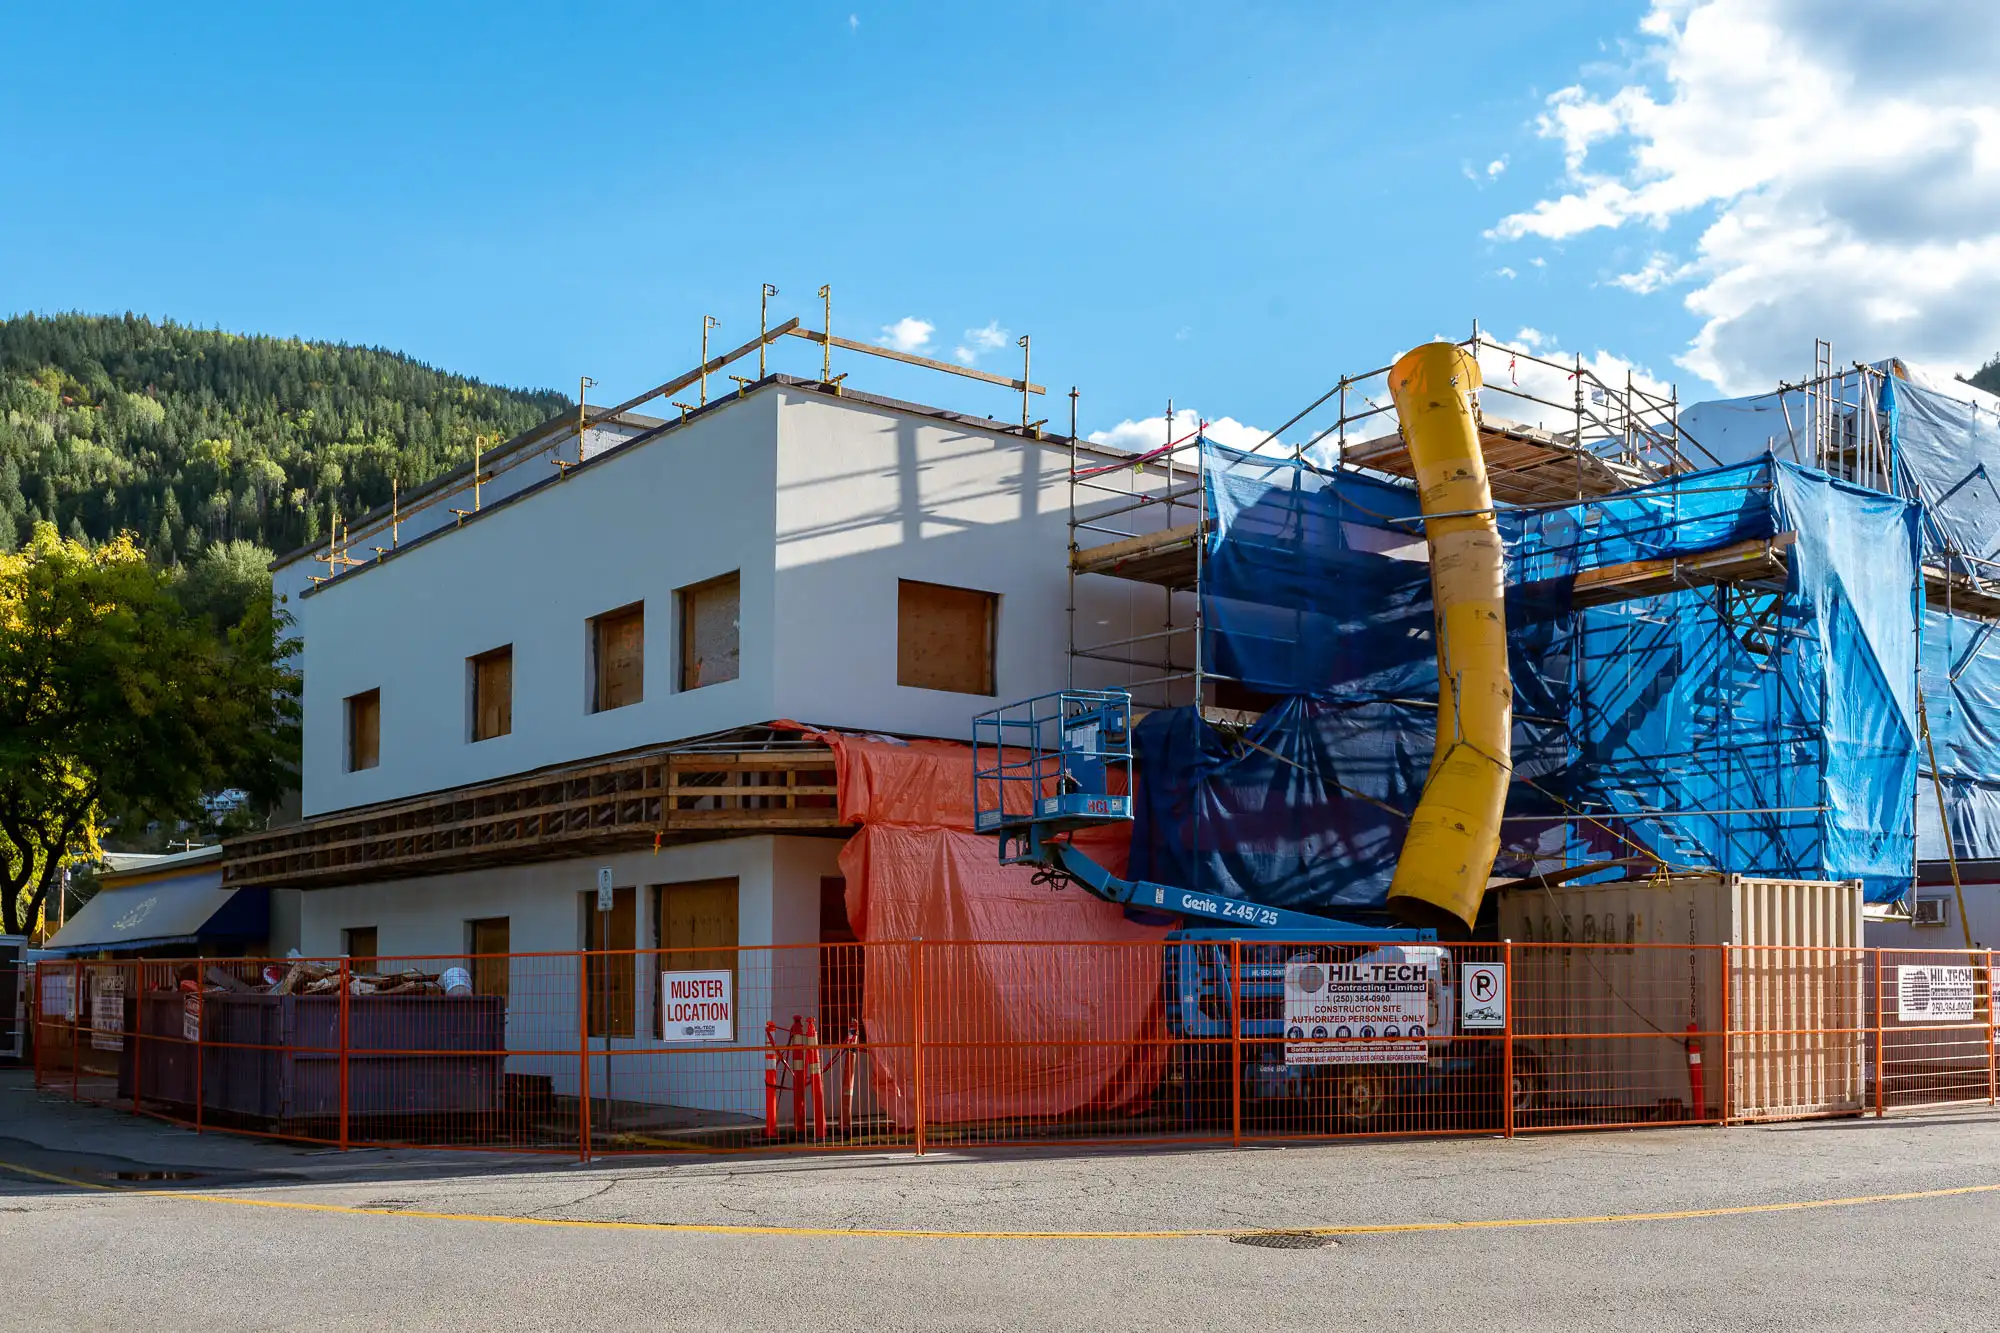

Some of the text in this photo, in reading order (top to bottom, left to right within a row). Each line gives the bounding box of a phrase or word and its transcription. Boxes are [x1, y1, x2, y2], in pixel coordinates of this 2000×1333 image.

[1087, 800, 1110, 813] HCL
[1182, 894, 1217, 913] Genie
[1222, 902, 1279, 925] Z-45/25
[1328, 965, 1427, 981] HIL-TECH
[671, 980, 723, 999] MUSTER
[1330, 983, 1425, 993] Contracting Limited
[1326, 994, 1391, 1005] 1 (250) 364-0900
[667, 1003, 729, 1022] LOCATION
[1314, 1004, 1402, 1014] CONSTRUCTION SITE
[1291, 1014, 1425, 1024] AUTHORIZED PERSONNEL ONLY
